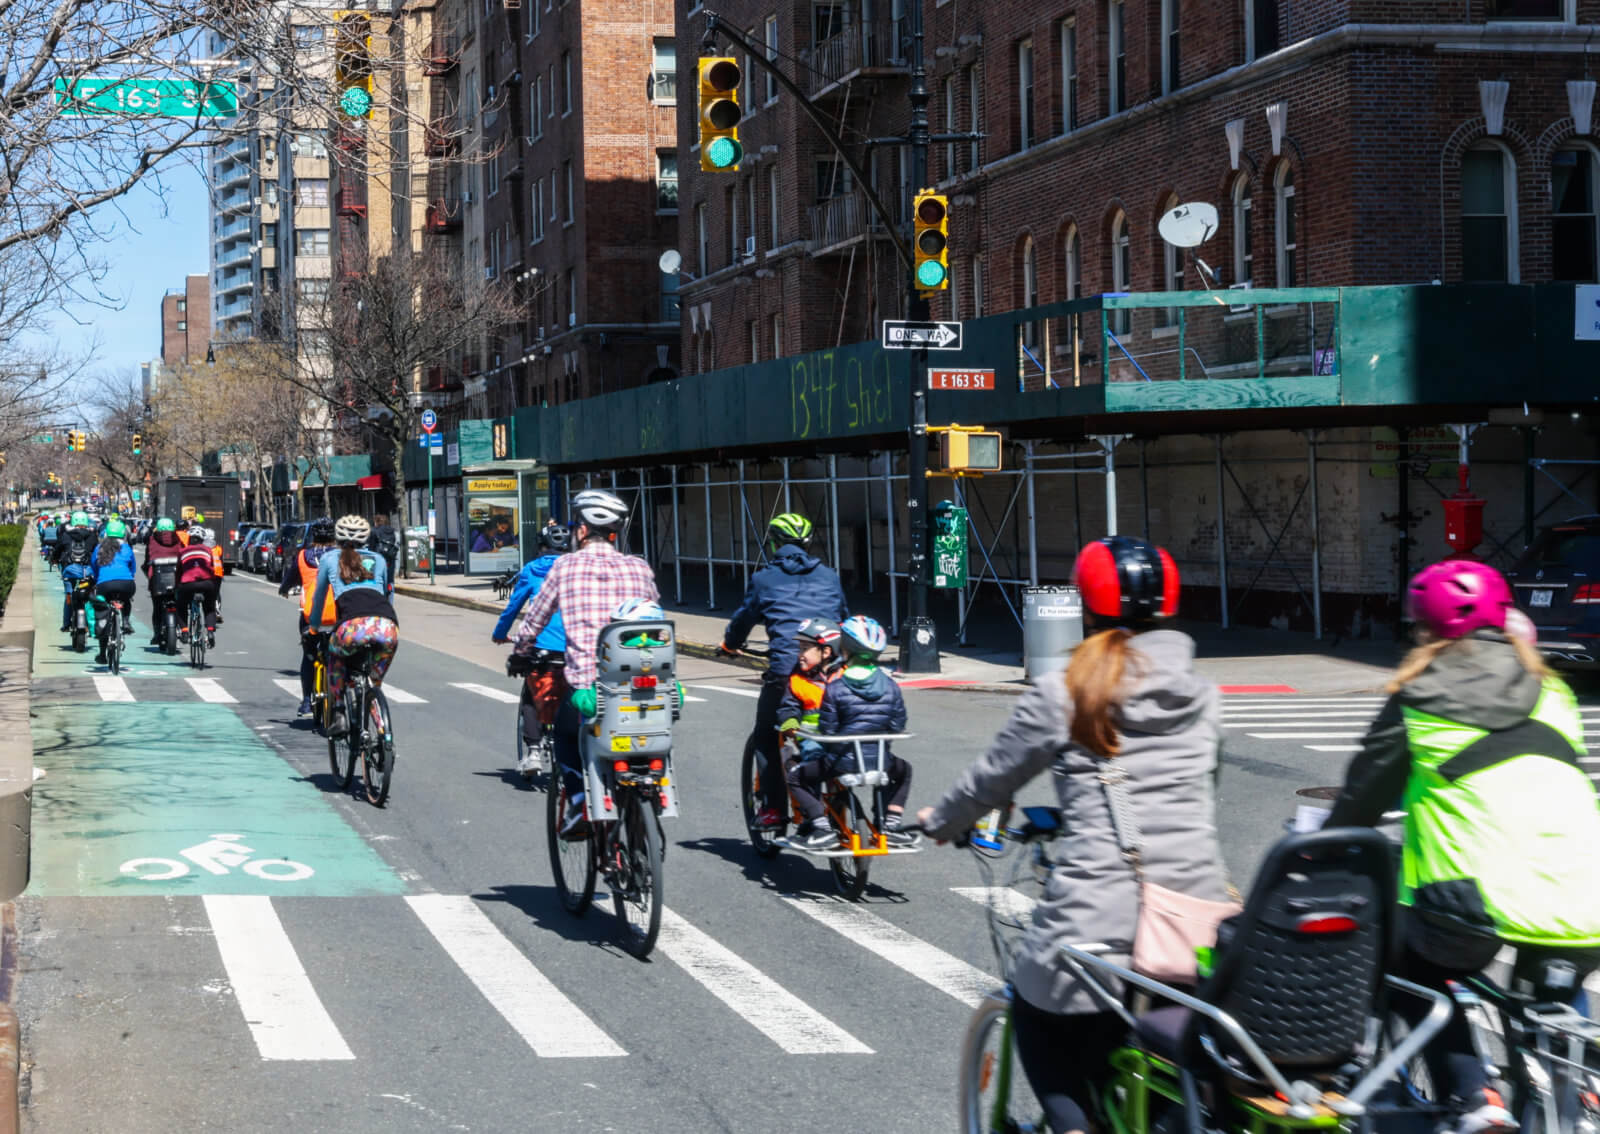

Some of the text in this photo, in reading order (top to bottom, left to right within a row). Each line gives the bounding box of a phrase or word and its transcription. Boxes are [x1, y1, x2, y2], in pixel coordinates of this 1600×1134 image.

[116, 88, 161, 108] 163
[895, 330, 950, 340] ONE WAY
[941, 374, 985, 388] E 163 St
[474, 481, 491, 489] Apply
